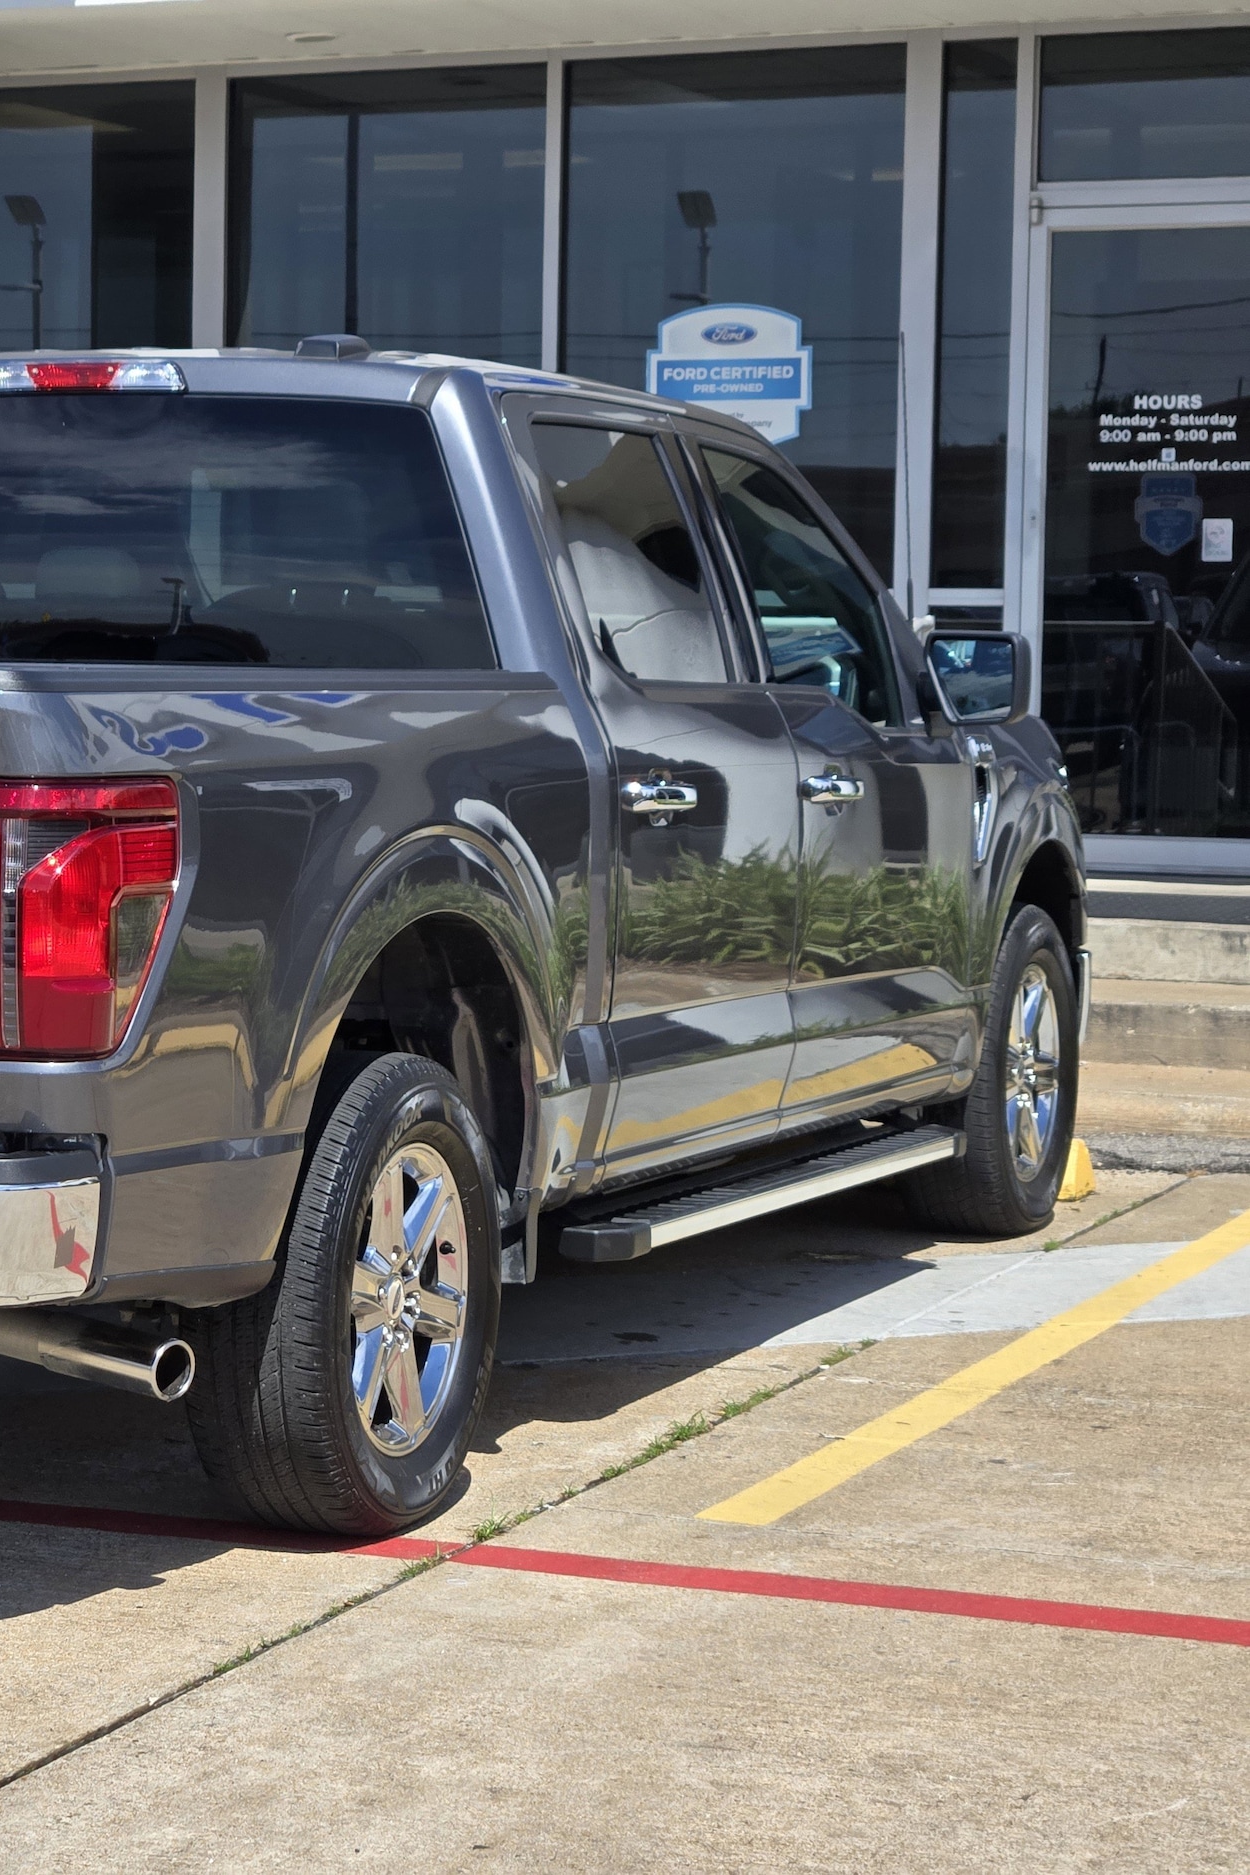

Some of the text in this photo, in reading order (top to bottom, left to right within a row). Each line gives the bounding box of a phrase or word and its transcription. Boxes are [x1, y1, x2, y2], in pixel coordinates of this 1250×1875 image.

[711, 324, 746, 341] Ford
[663, 365, 794, 381] FORD CERTIFIED
[693, 382, 763, 393] PRE-OWNED
[1134, 394, 1203, 410] HOURS
[1099, 414, 1157, 428] Monday
[1169, 413, 1237, 428] Saturday
[1099, 429, 1131, 442] 9:00
[1136, 432, 1161, 442] am
[1174, 429, 1208, 442] 9:00
[1212, 431, 1237, 443] pm
